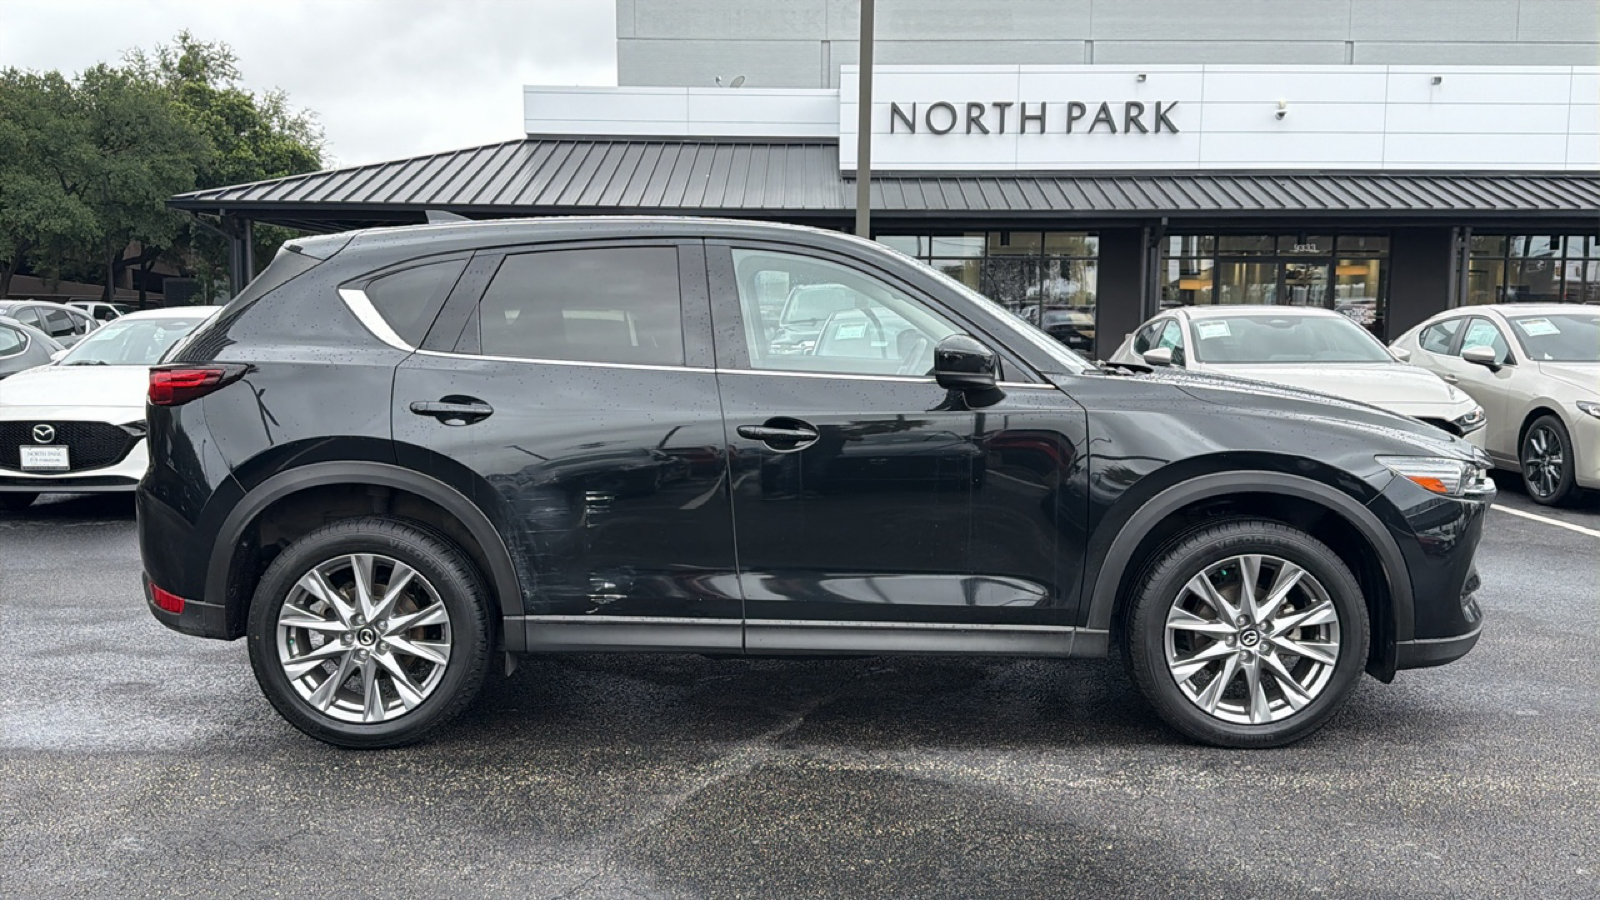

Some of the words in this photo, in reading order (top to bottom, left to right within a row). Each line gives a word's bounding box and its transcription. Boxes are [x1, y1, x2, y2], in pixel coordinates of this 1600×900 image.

[890, 100, 1046, 135] NORTH
[1066, 101, 1179, 135] PARK
[389, 539, 450, 580] VELOCITY
